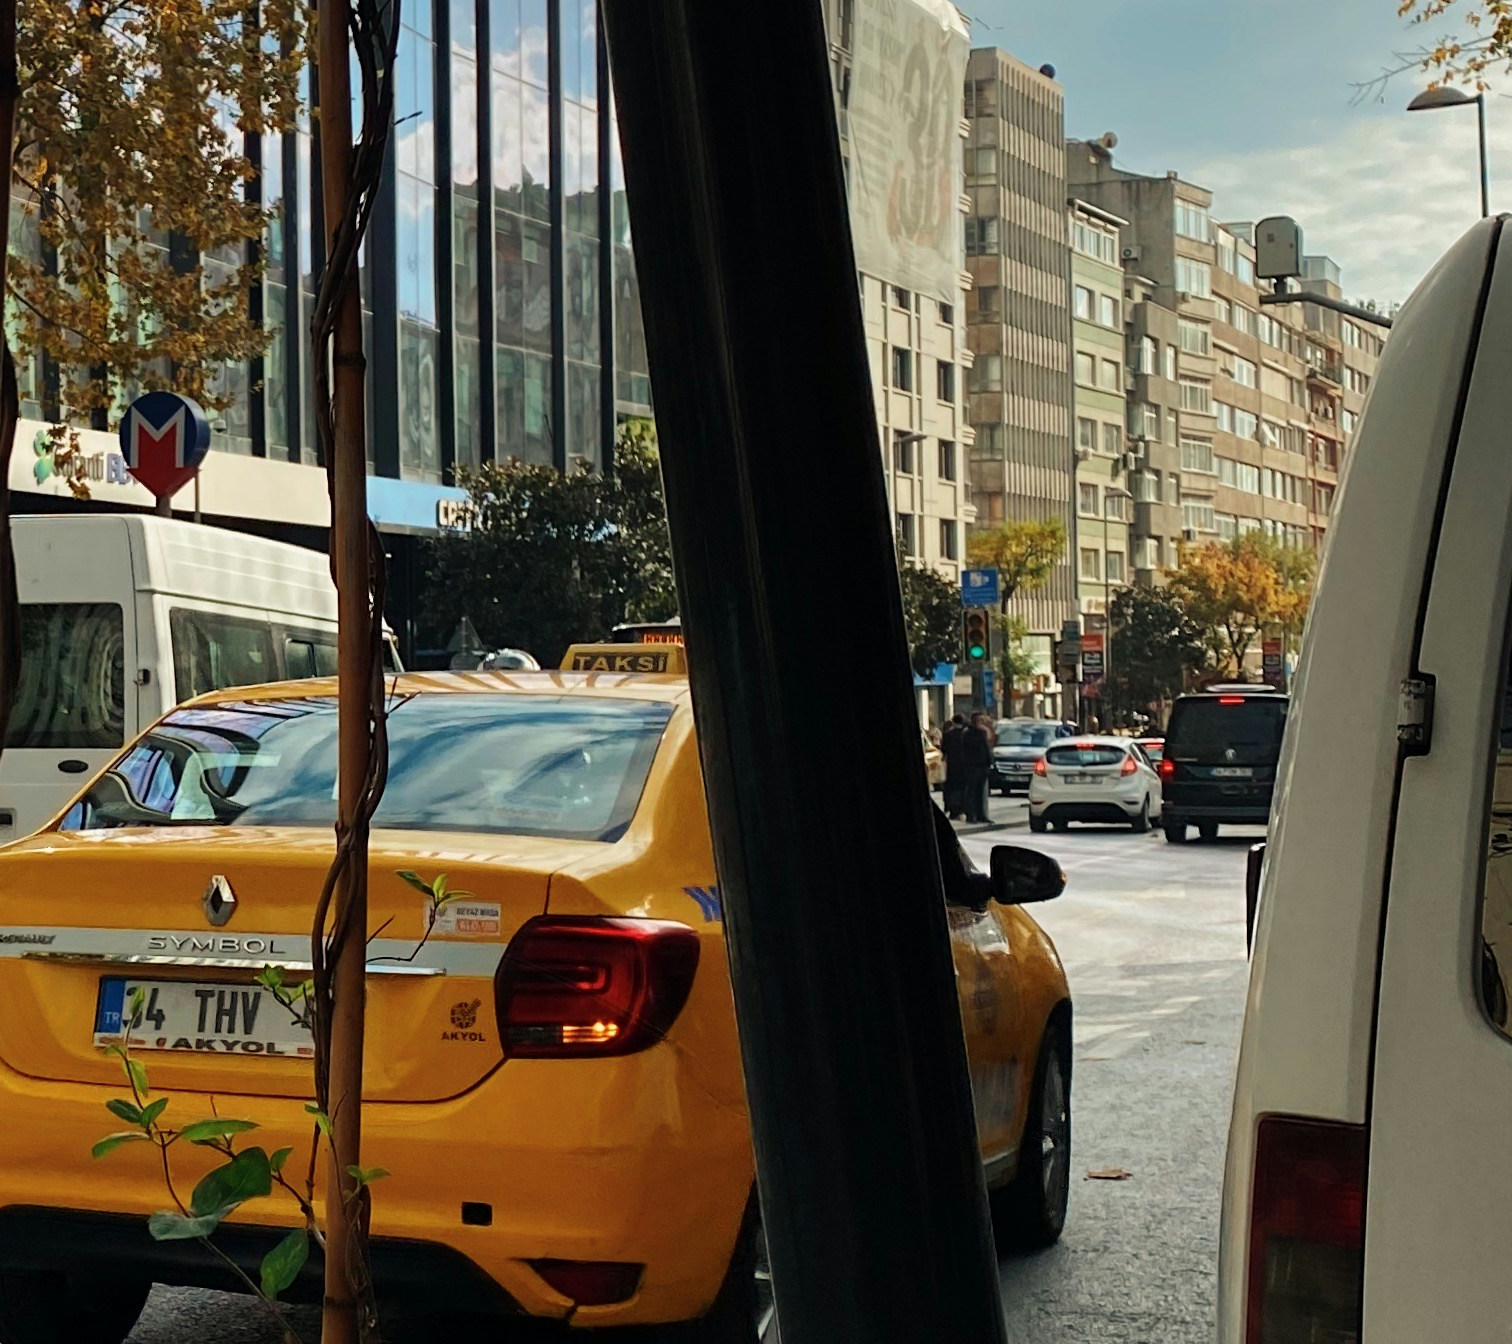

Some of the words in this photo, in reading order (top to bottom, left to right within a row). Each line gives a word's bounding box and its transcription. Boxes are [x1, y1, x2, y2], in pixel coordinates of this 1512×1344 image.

[147, 935, 287, 955] SYMBOL
[195, 989, 262, 1035] THV
[171, 1037, 285, 1055] AKYOL
[441, 1032, 486, 1042] AKYOL
